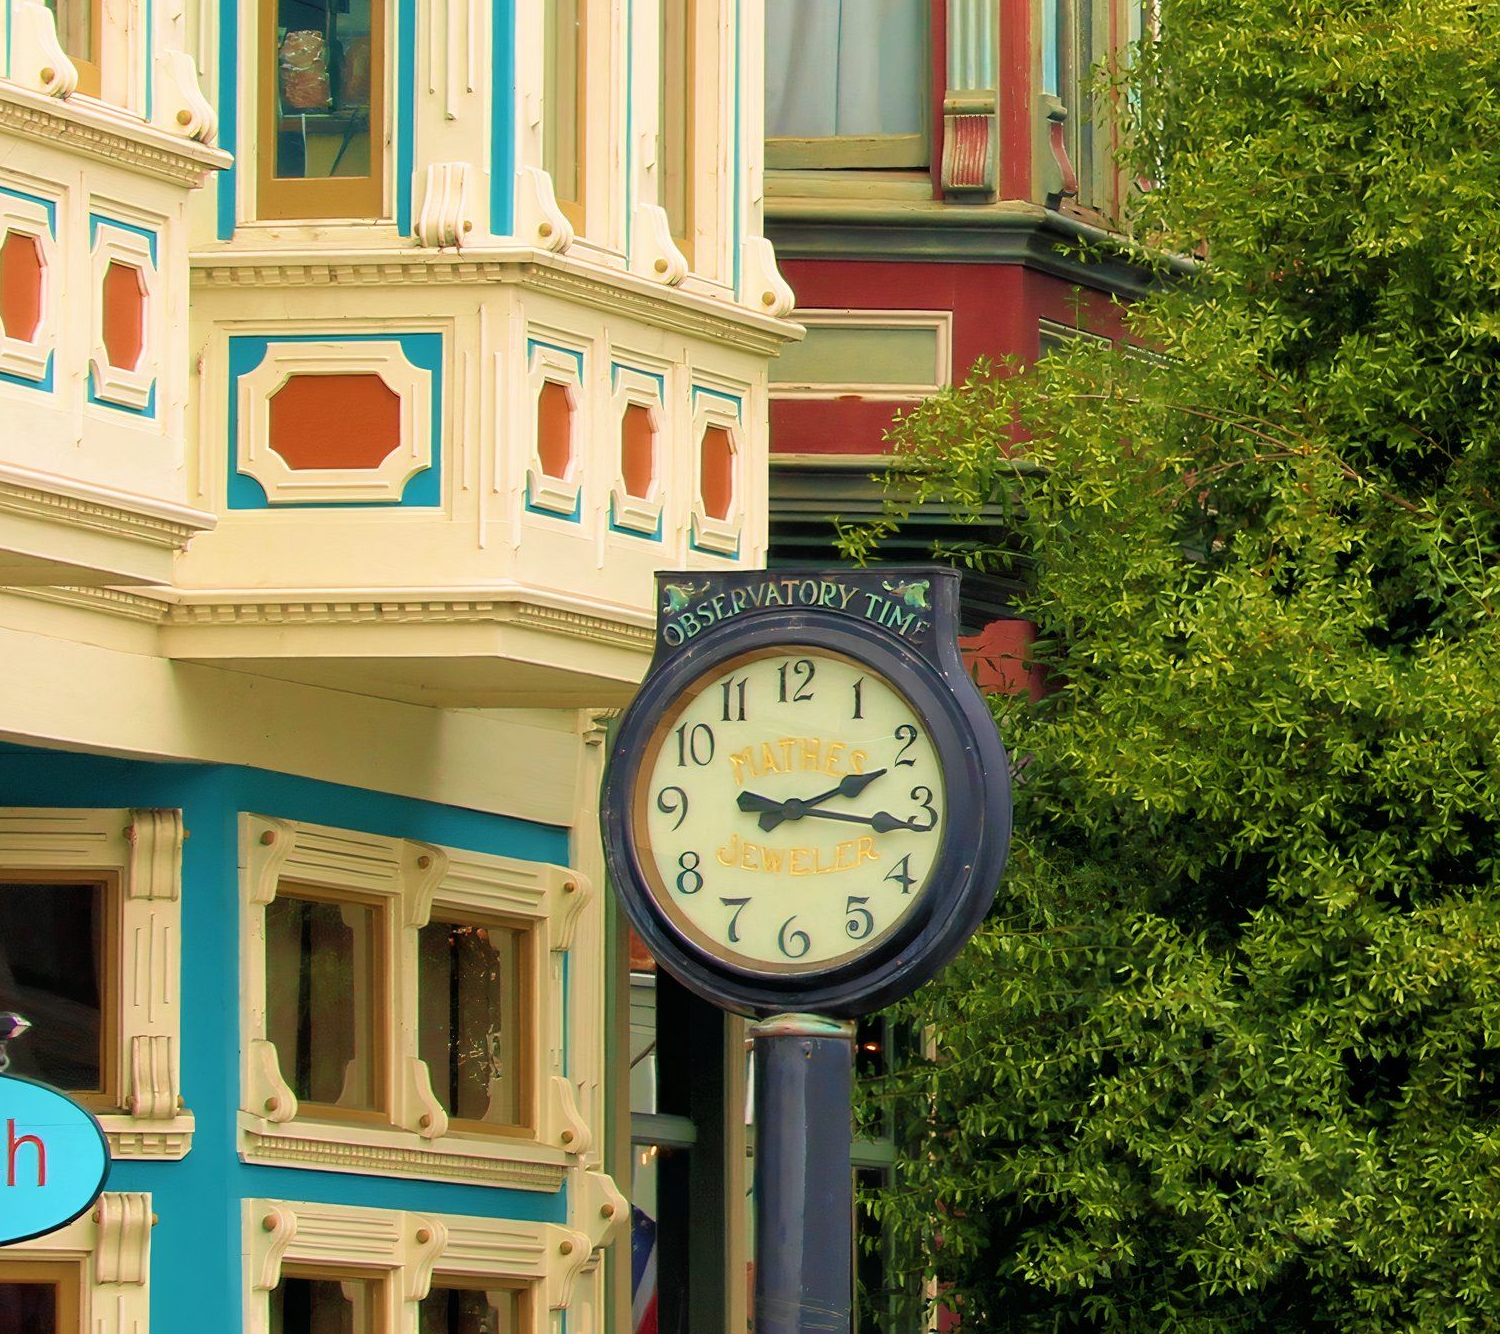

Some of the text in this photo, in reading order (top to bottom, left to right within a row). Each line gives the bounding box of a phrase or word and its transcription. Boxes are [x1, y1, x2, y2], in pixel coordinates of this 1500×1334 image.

[663, 579, 931, 646] OBSERVATORY TIME
[721, 676, 748, 722] 11
[777, 659, 815, 703] 12
[852, 677, 864, 720] 1
[675, 722, 715, 767] 10
[729, 737, 869, 785] MATHES
[894, 724, 918, 767] 2
[657, 786, 689, 832] 9
[907, 786, 939, 832] 3
[676, 851, 704, 895] 8
[715, 833, 880, 876] JEWELER
[884, 853, 918, 894] 4
[719, 897, 752, 942] 7
[778, 915, 811, 958] 6
[845, 896, 874, 939] 5
